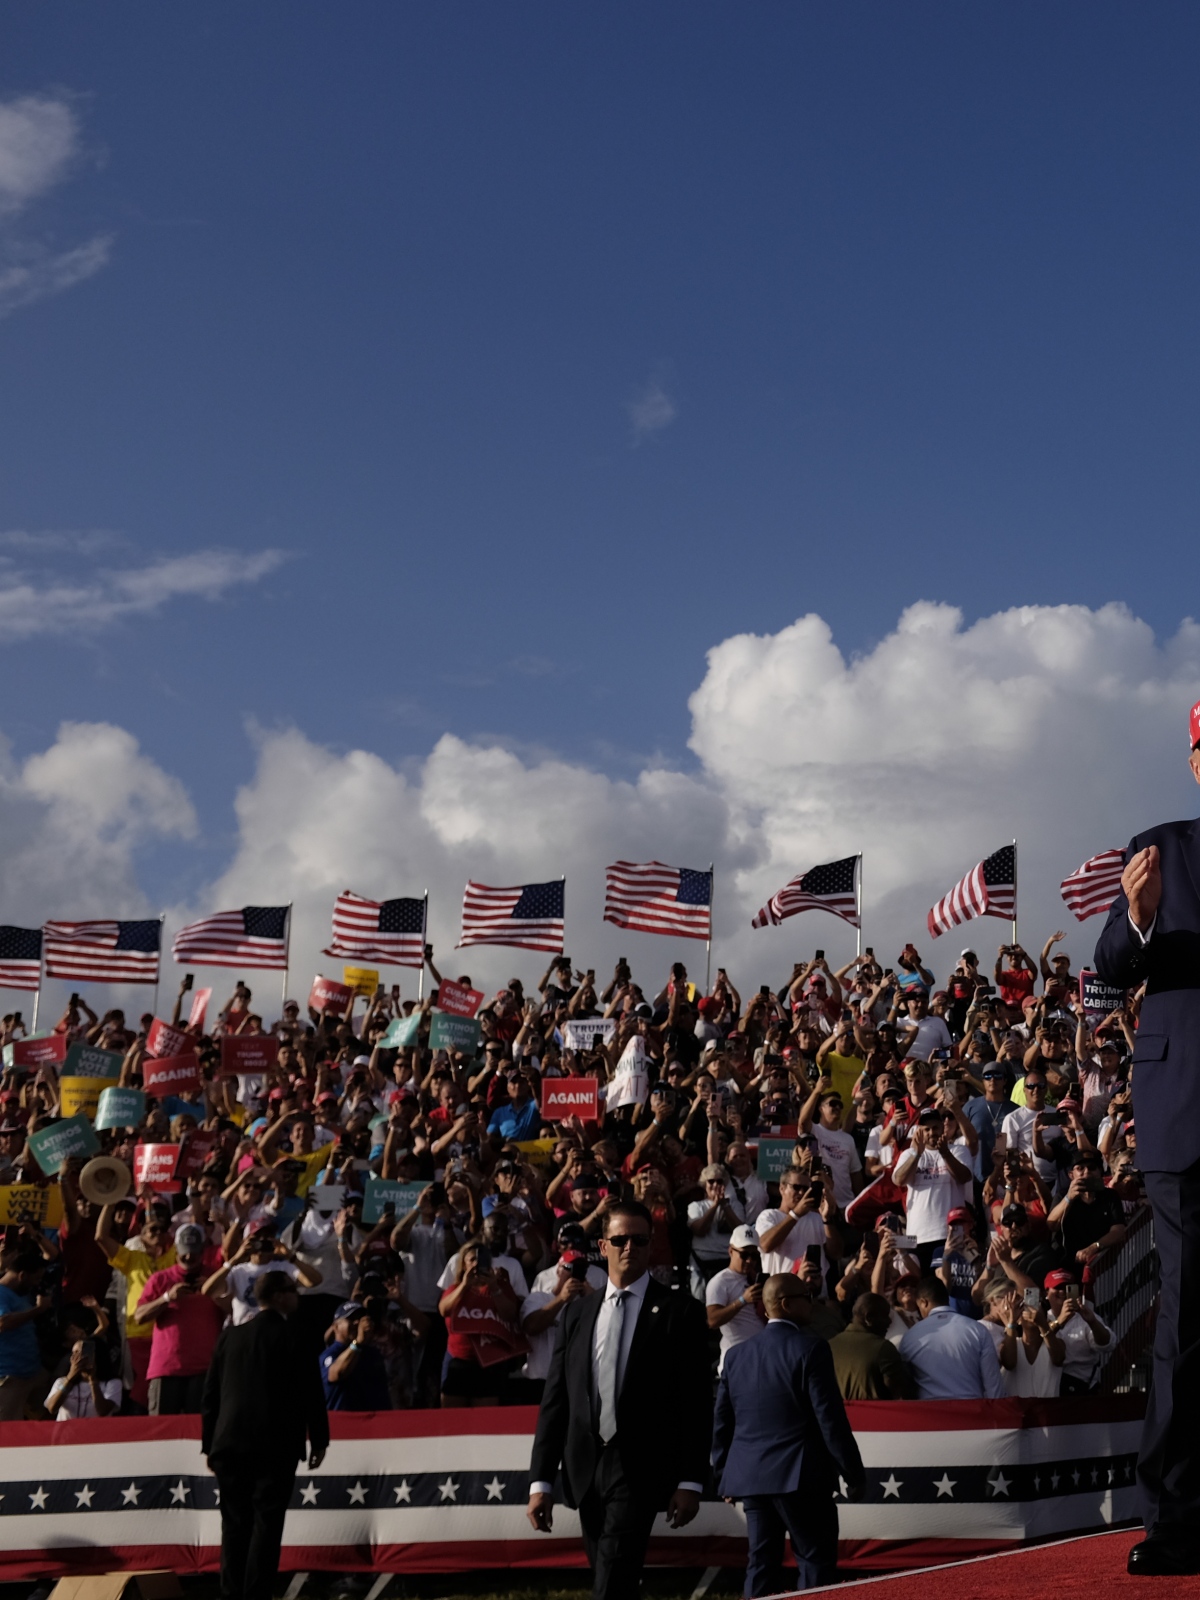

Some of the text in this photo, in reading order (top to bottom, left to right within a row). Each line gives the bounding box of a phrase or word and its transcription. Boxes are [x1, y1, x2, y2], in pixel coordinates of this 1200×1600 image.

[445, 986, 477, 1004] CUBANS
[442, 997, 470, 1013] TRUMP!
[1083, 997, 1124, 1008] CABRERA
[437, 1020, 476, 1034] LATINOS
[574, 1024, 611, 1033] TRUMP
[438, 1034, 471, 1046] TRUMP!
[81, 1049, 112, 1063] VOTE
[77, 1059, 109, 1073] VOTE
[148, 1066, 197, 1085] AGAIN!
[547, 1092, 594, 1104] AGAIN!
[36, 1124, 82, 1152] LATINOS
[46, 1140, 87, 1165] TRUMP!
[10, 1190, 50, 1200] VOTE
[8, 1199, 48, 1211] VOTE
[950, 1262, 976, 1277] RUM
